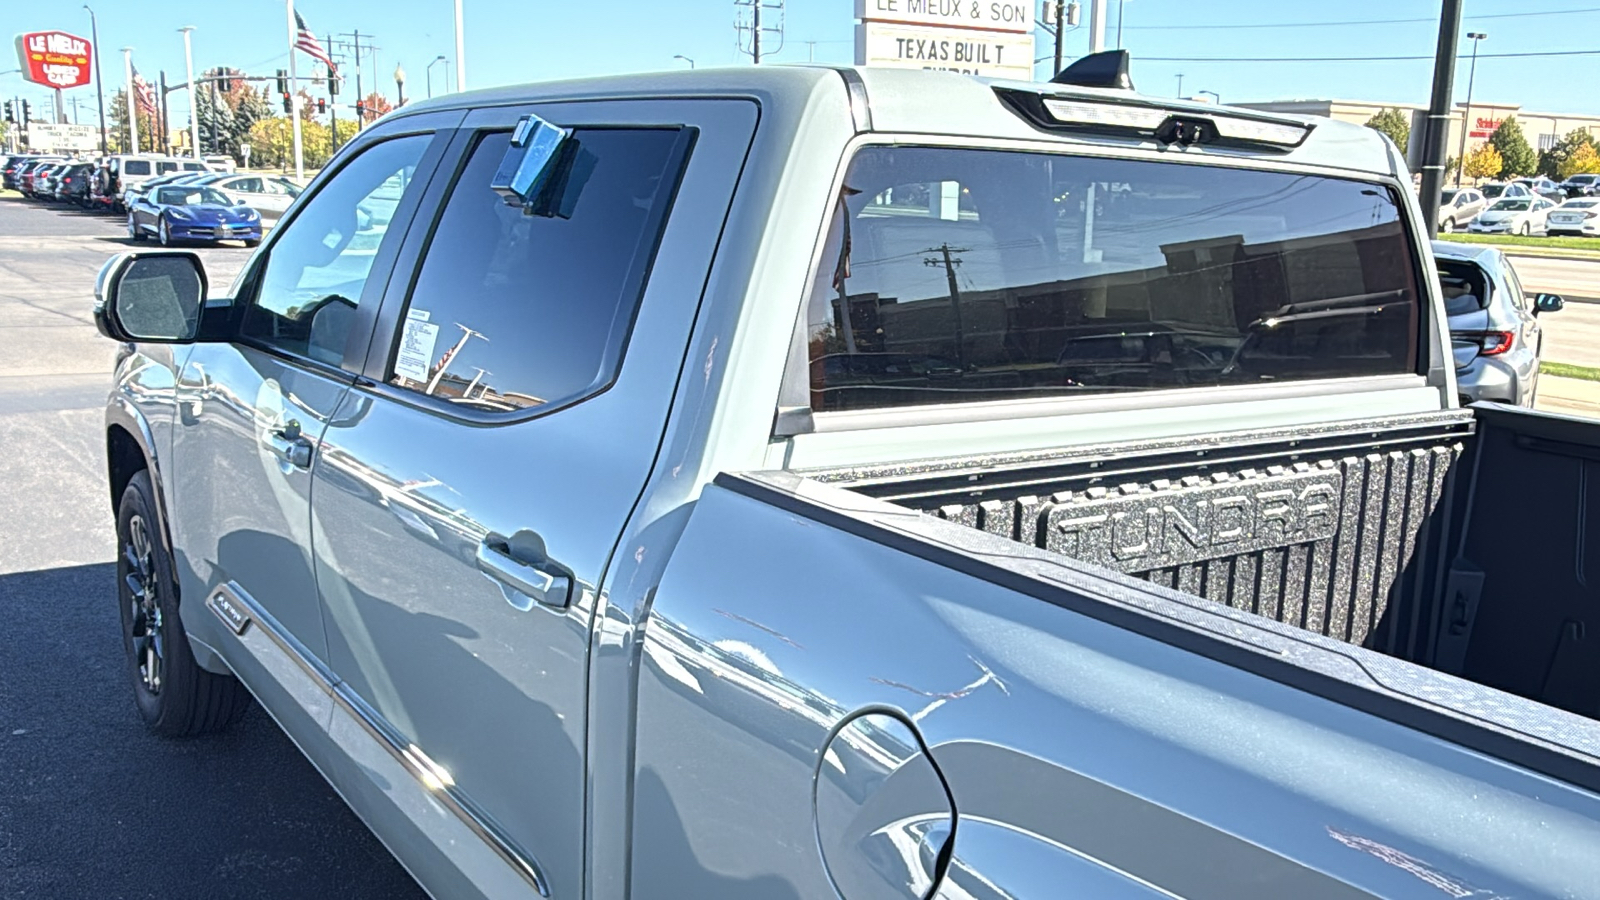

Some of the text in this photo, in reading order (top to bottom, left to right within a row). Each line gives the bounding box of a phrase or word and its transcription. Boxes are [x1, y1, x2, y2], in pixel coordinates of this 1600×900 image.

[877, 0, 1026, 23] LE MIEUX & SON
[29, 35, 46, 52] LE
[896, 38, 1004, 64] TEXAS BUILT
[42, 63, 80, 77] USED
[47, 73, 77, 86] CARS
[1057, 482, 1335, 562] TUNDRA
